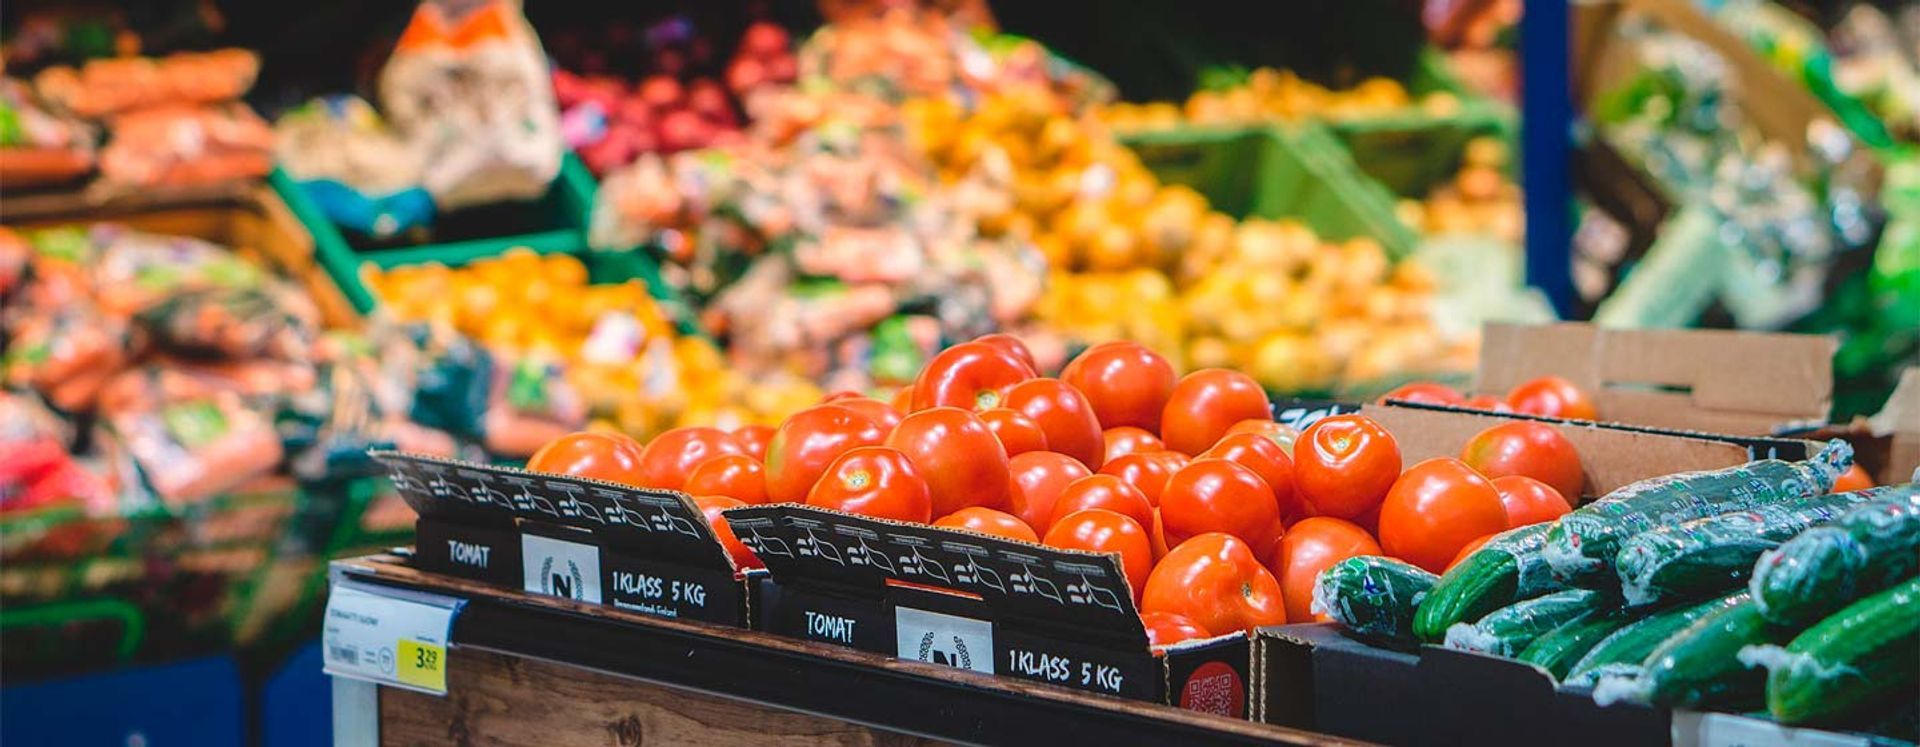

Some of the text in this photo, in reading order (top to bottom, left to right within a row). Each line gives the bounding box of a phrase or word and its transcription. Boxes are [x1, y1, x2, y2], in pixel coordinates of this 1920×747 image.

[448, 540, 491, 568] TOMAT
[552, 573, 572, 598] N
[620, 572, 663, 598] KLASS
[672, 581, 680, 601] 5
[684, 582, 706, 607] KG
[805, 611, 856, 643] TOMAT
[1018, 651, 1070, 681] KLASS
[1081, 662, 1092, 685] 5
[1096, 664, 1124, 692] KG
